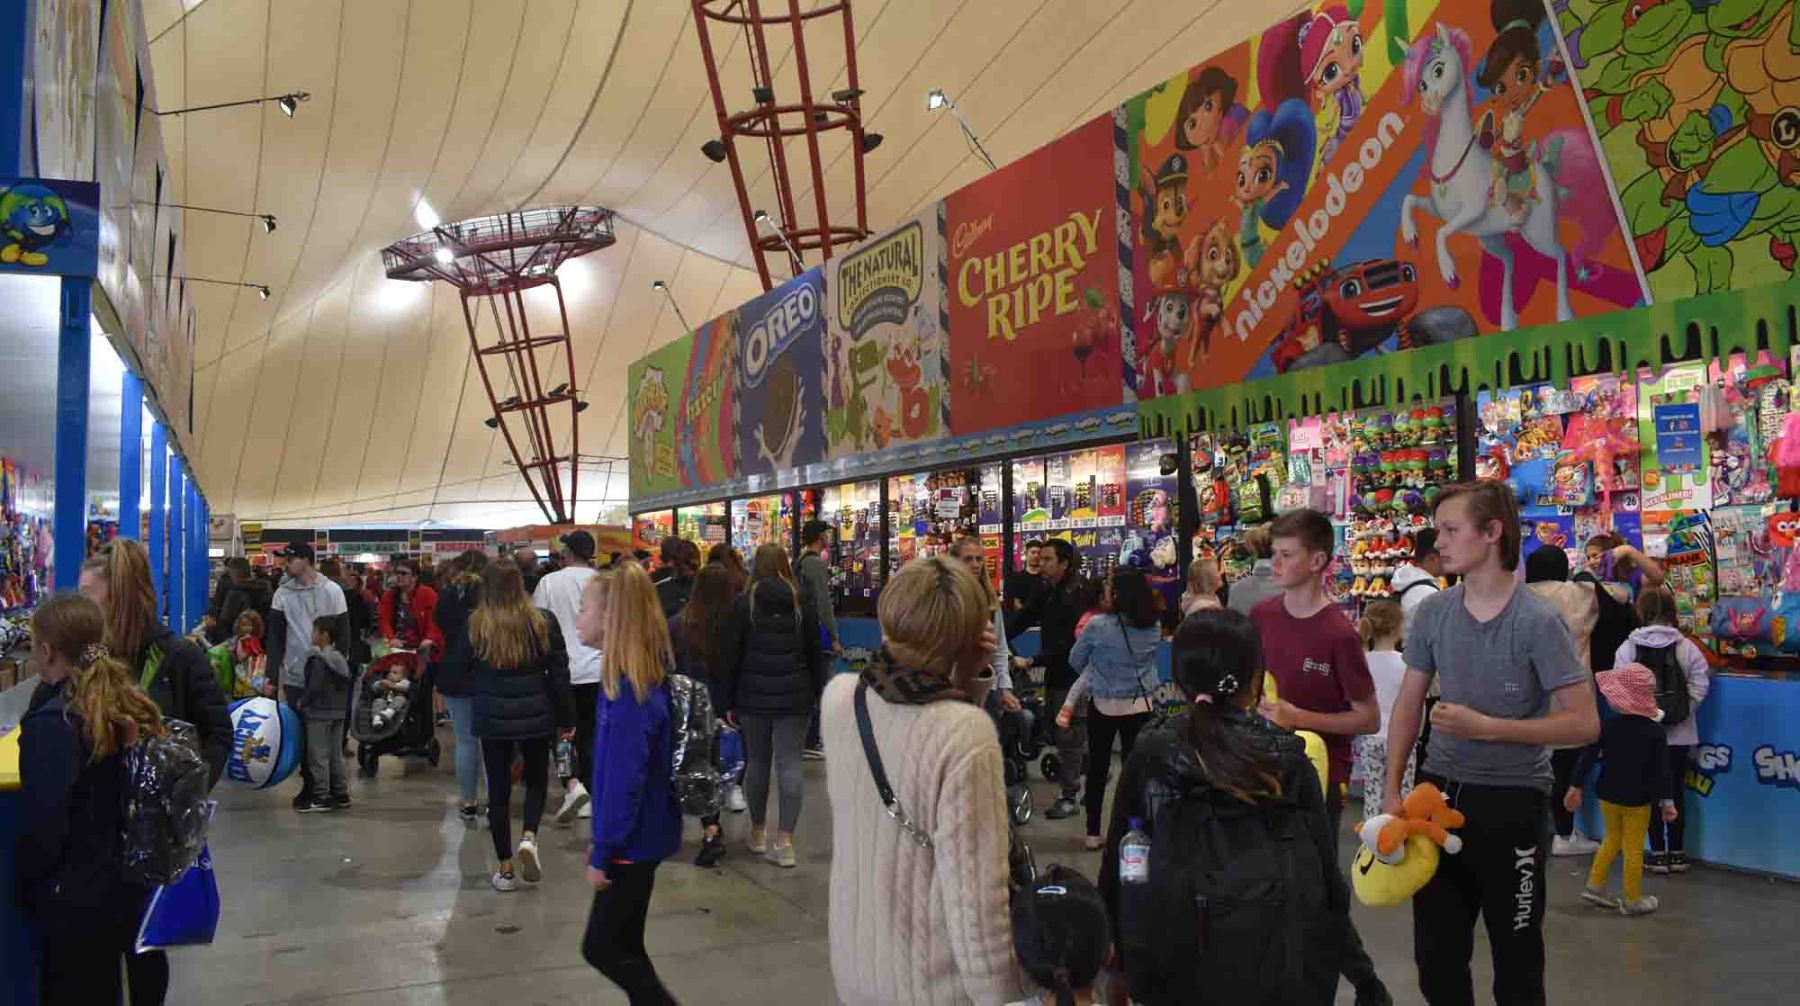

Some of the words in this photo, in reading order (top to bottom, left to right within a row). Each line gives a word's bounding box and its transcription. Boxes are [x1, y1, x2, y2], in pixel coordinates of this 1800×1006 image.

[952, 212, 994, 259] Cadbury
[958, 208, 1103, 309] CHERRY
[1235, 112, 1405, 343] nickelodeon
[841, 261, 862, 307] THE
[863, 233, 919, 279] NATURAL
[987, 267, 1081, 342] RIPE
[746, 289, 816, 376] OREO
[1513, 868, 1534, 931] Hurley
